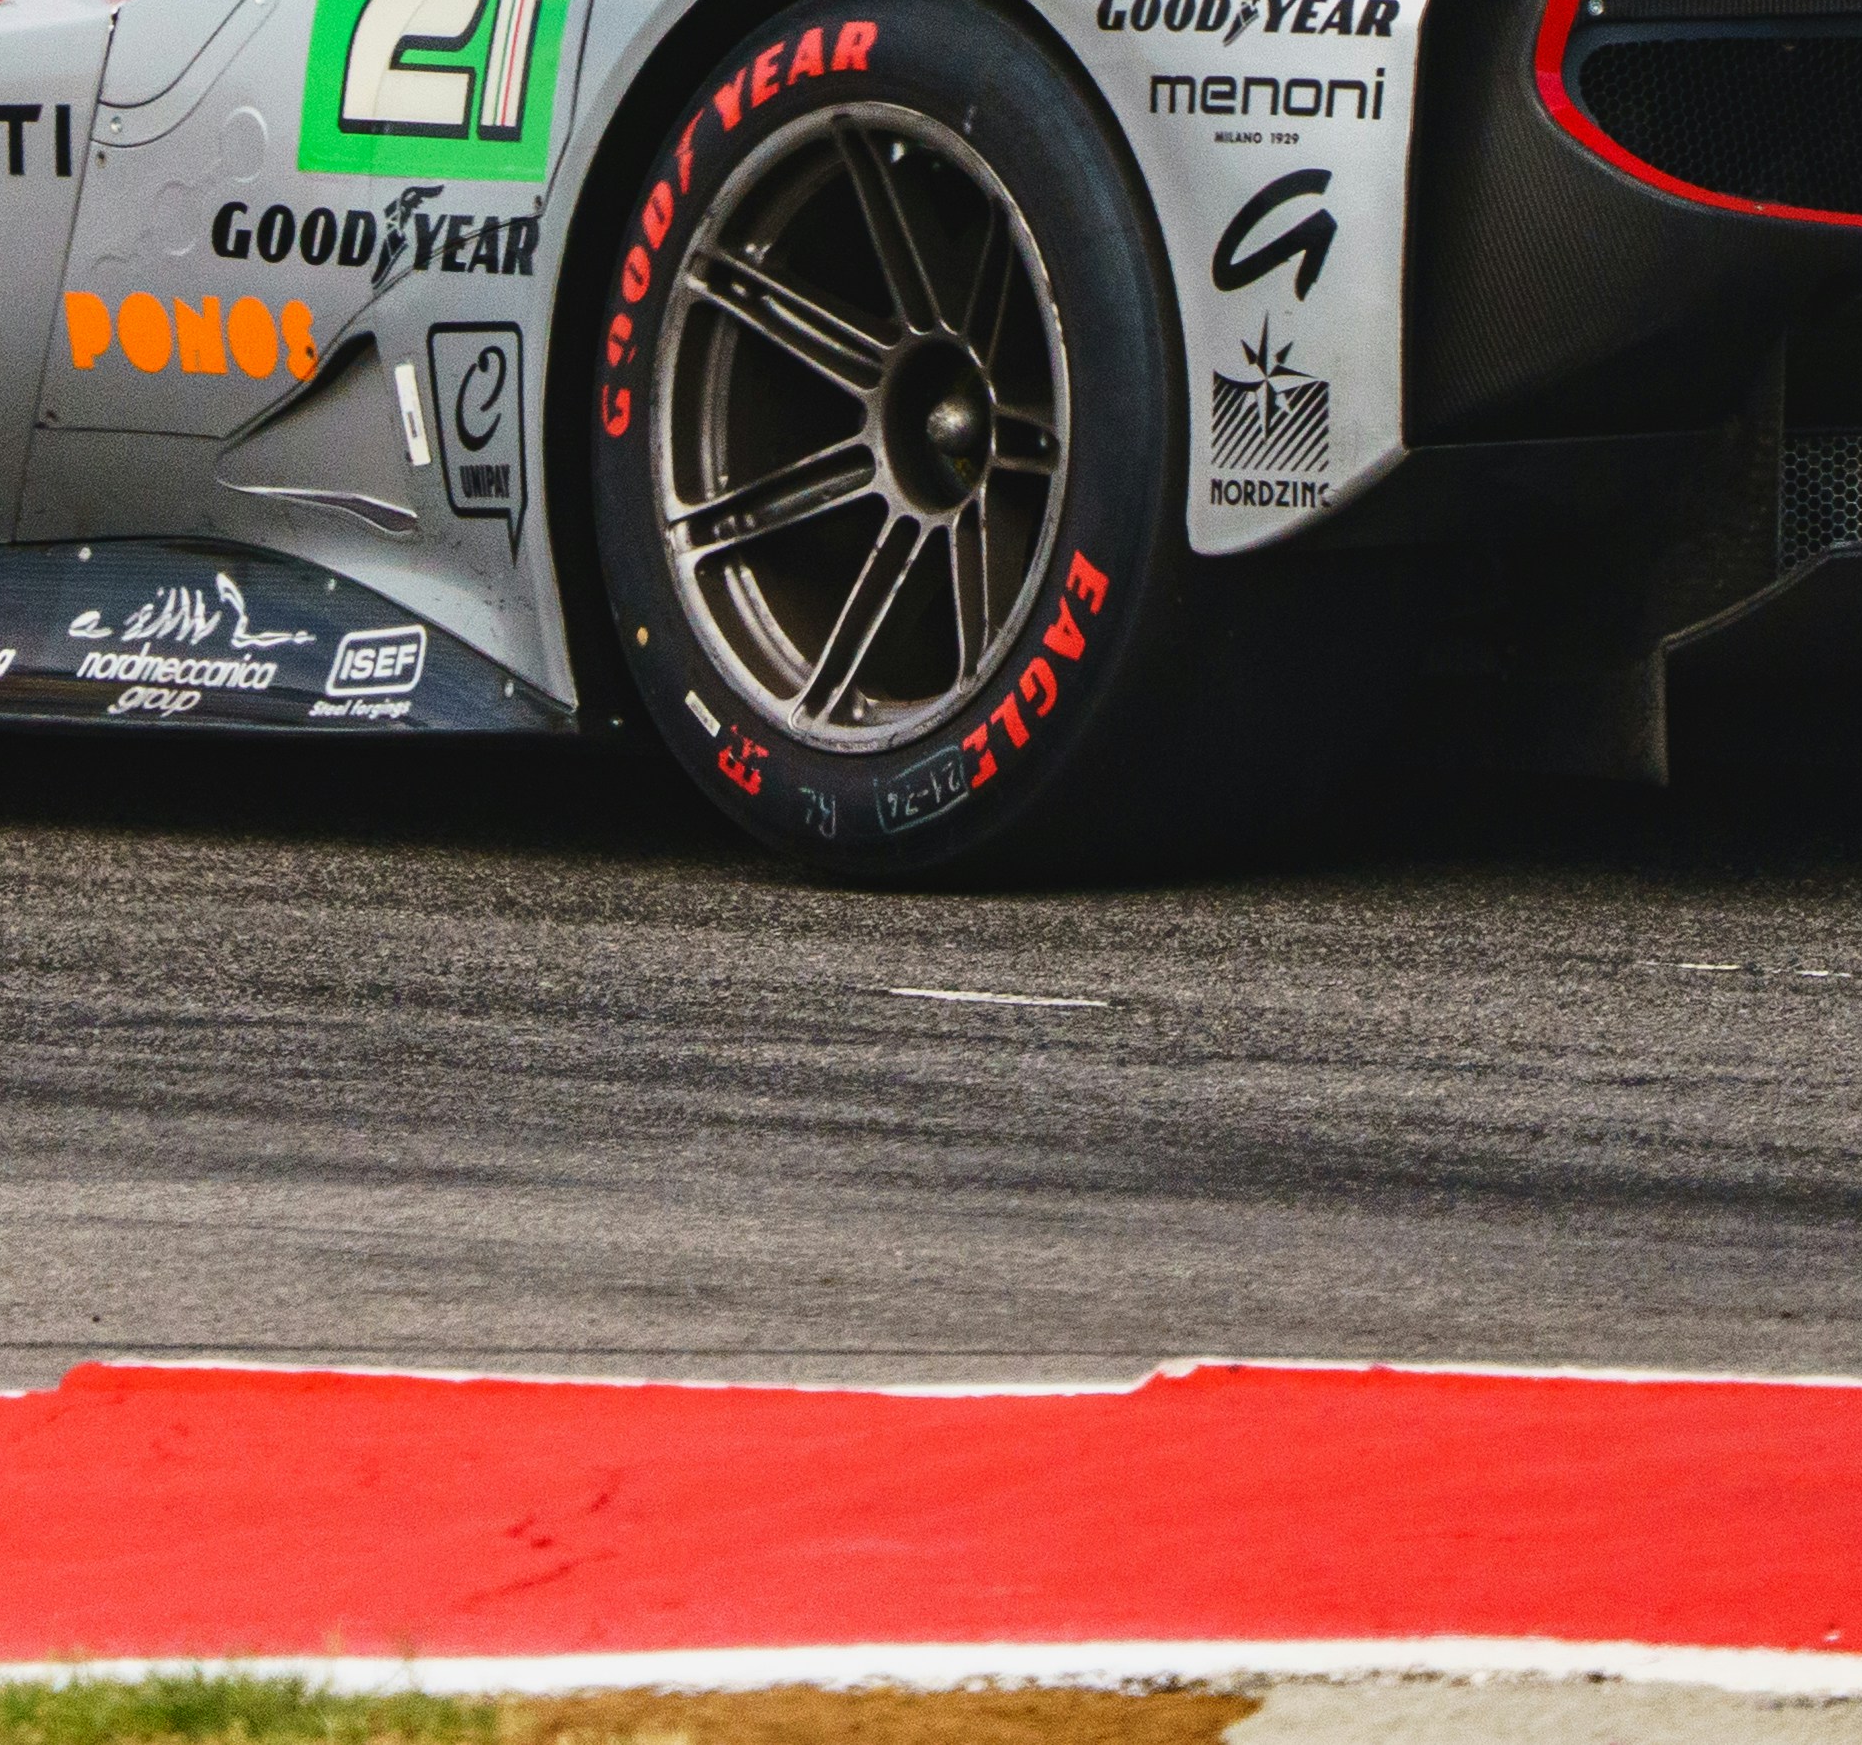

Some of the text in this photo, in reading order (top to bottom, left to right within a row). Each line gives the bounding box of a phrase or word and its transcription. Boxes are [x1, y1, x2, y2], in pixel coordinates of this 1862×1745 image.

[1149, 66, 1387, 121] menoni
[1270, 132, 1300, 145] 1929
[211, 199, 541, 277] GOODYEAR
[64, 290, 318, 382] PONOS
[459, 463, 510, 498] UNIPAY
[1210, 478, 1332, 509] NORDZINC
[76, 641, 278, 690] nordmeccanica
[339, 643, 418, 681] ISEF
[106, 685, 202, 718] group
